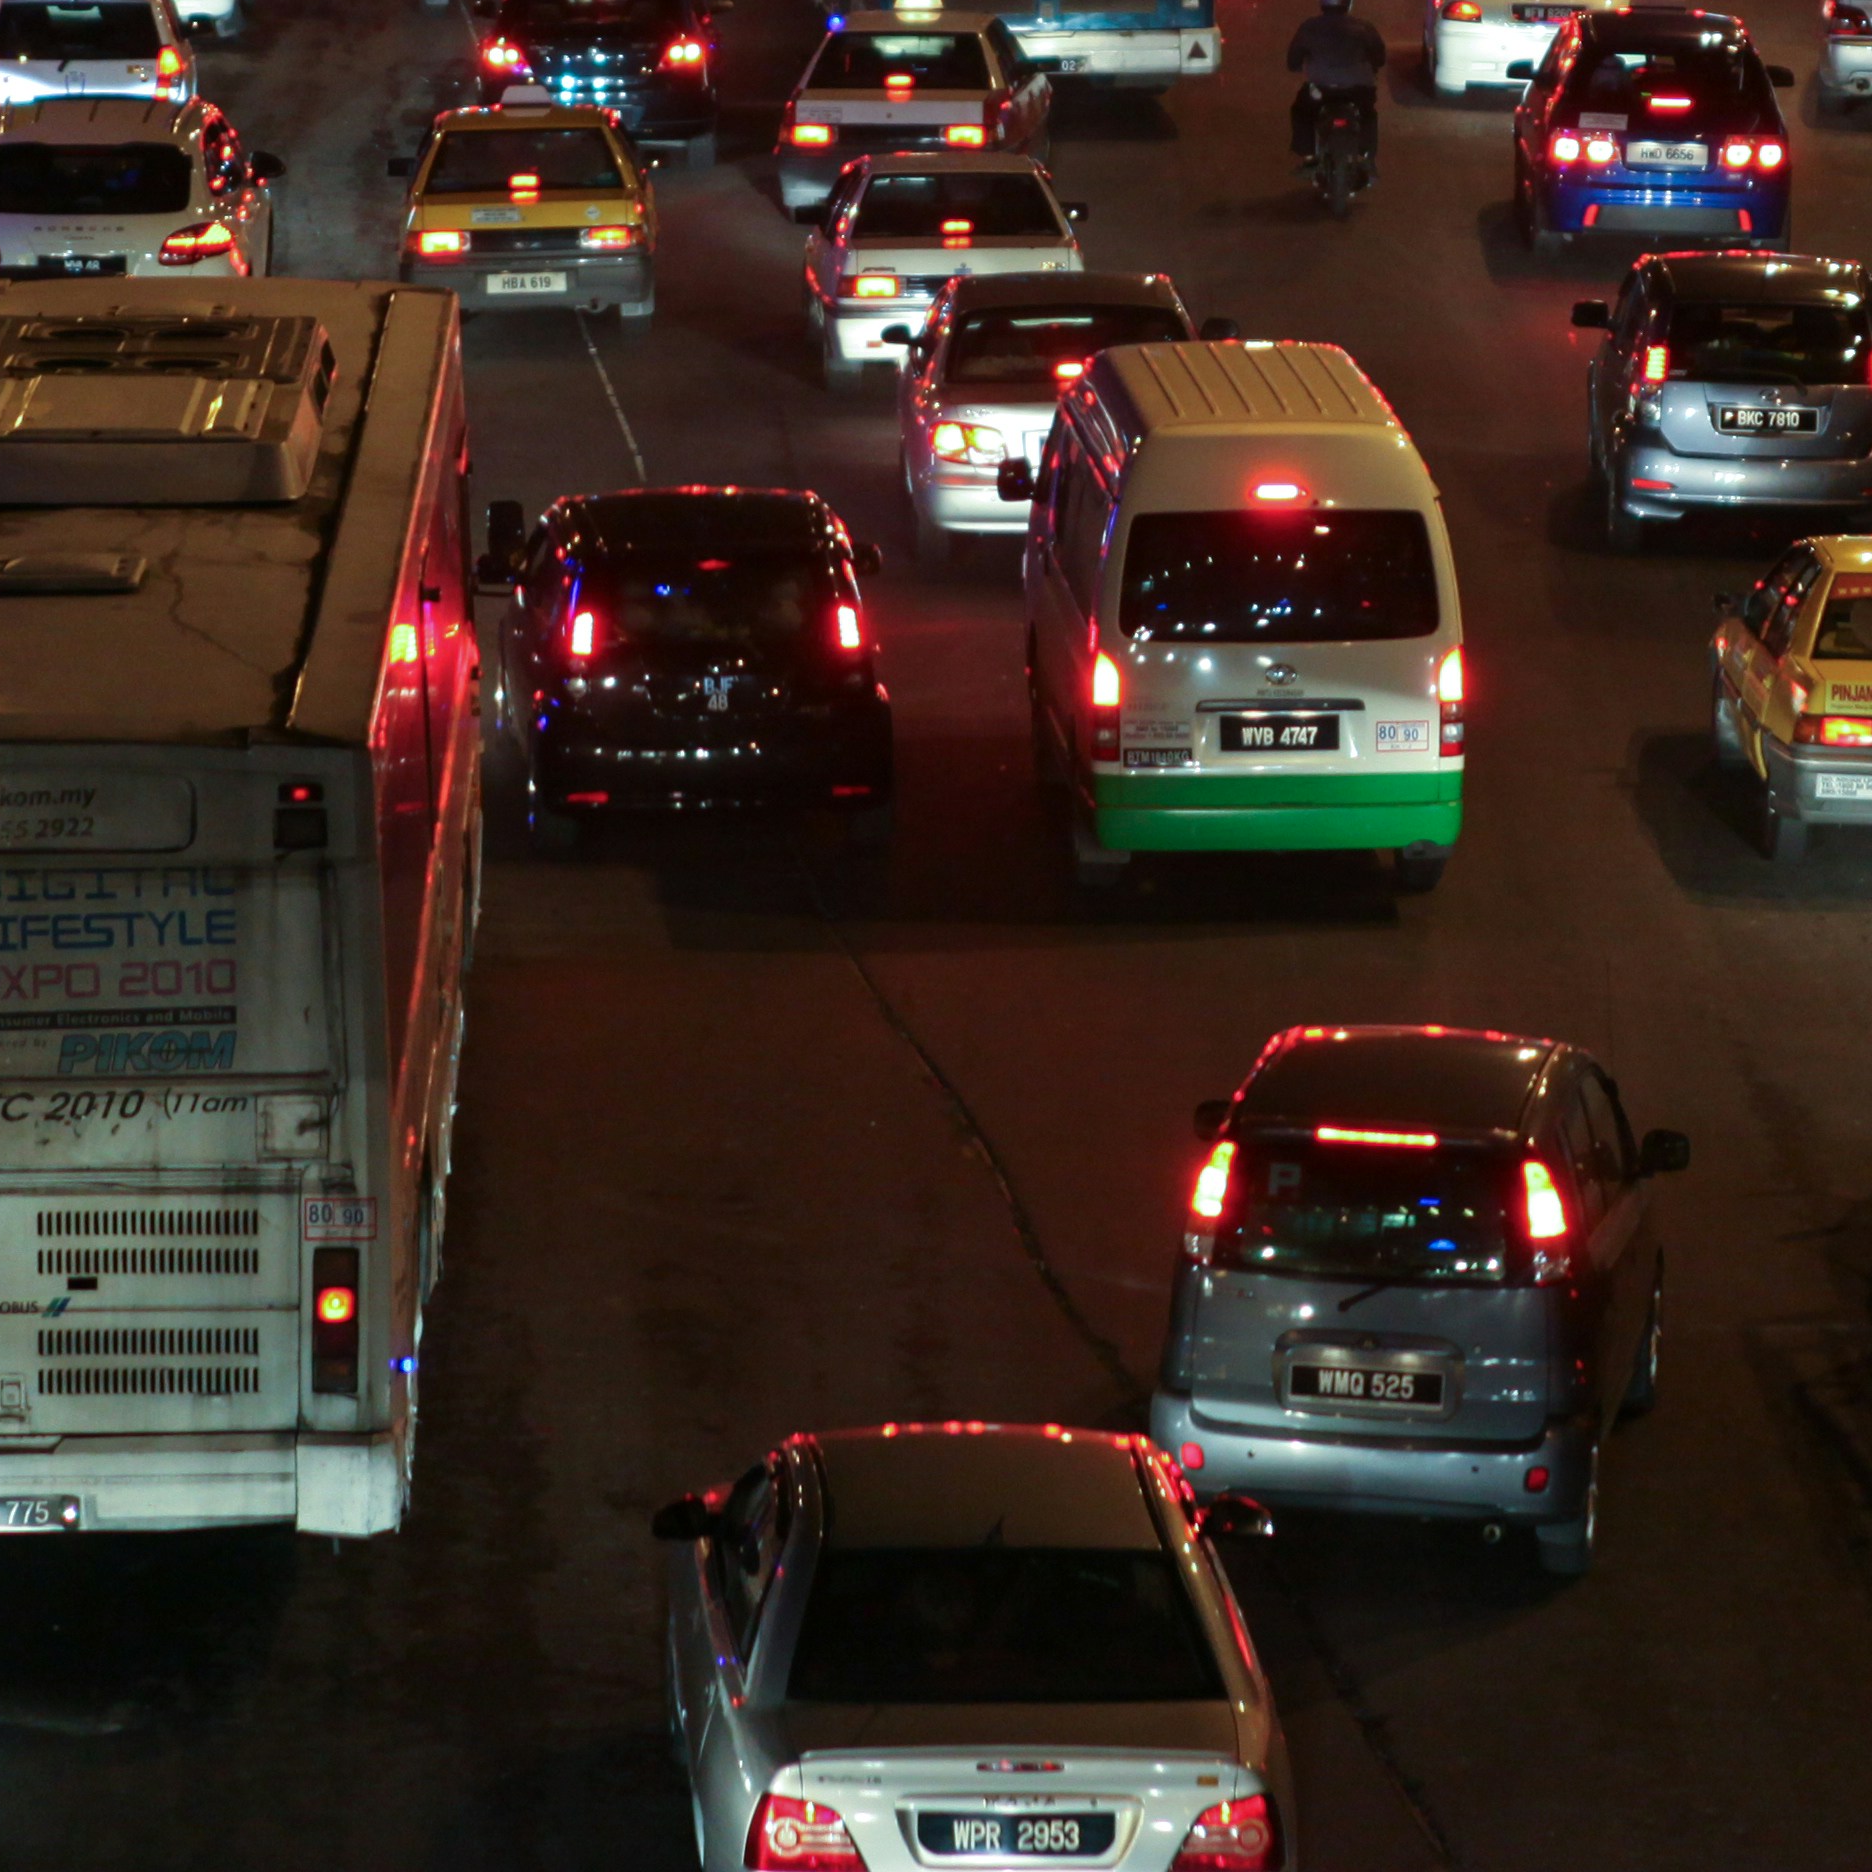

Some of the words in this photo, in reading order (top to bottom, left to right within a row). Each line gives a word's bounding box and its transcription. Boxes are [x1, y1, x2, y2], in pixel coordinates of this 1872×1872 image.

[502, 278, 526, 290] HBA
[530, 276, 552, 289] 619
[1737, 410, 1764, 427] BKC
[1768, 411, 1800, 428] 7810
[1241, 726, 1275, 746] WVB
[1278, 725, 1318, 745] 4747
[1378, 725, 1396, 739] 80
[1403, 728, 1419, 741] 90
[35, 815, 95, 840] 2922
[118, 958, 237, 999] 2010
[56, 1009, 141, 1027] Electronics
[145, 1008, 176, 1025] and
[179, 1005, 232, 1024] Mobile
[56, 1029, 238, 1075] PIKOM
[43, 1088, 145, 1119] 2010
[1270, 1163, 1303, 1196] P
[308, 1204, 333, 1224] 80
[341, 1208, 365, 1225] 90
[1317, 1369, 1364, 1396] WMQ
[1370, 1372, 1415, 1400] 525
[6, 1500, 50, 1524] 775
[952, 1818, 1002, 1849] WPR
[1017, 1819, 1080, 1851] 2953
